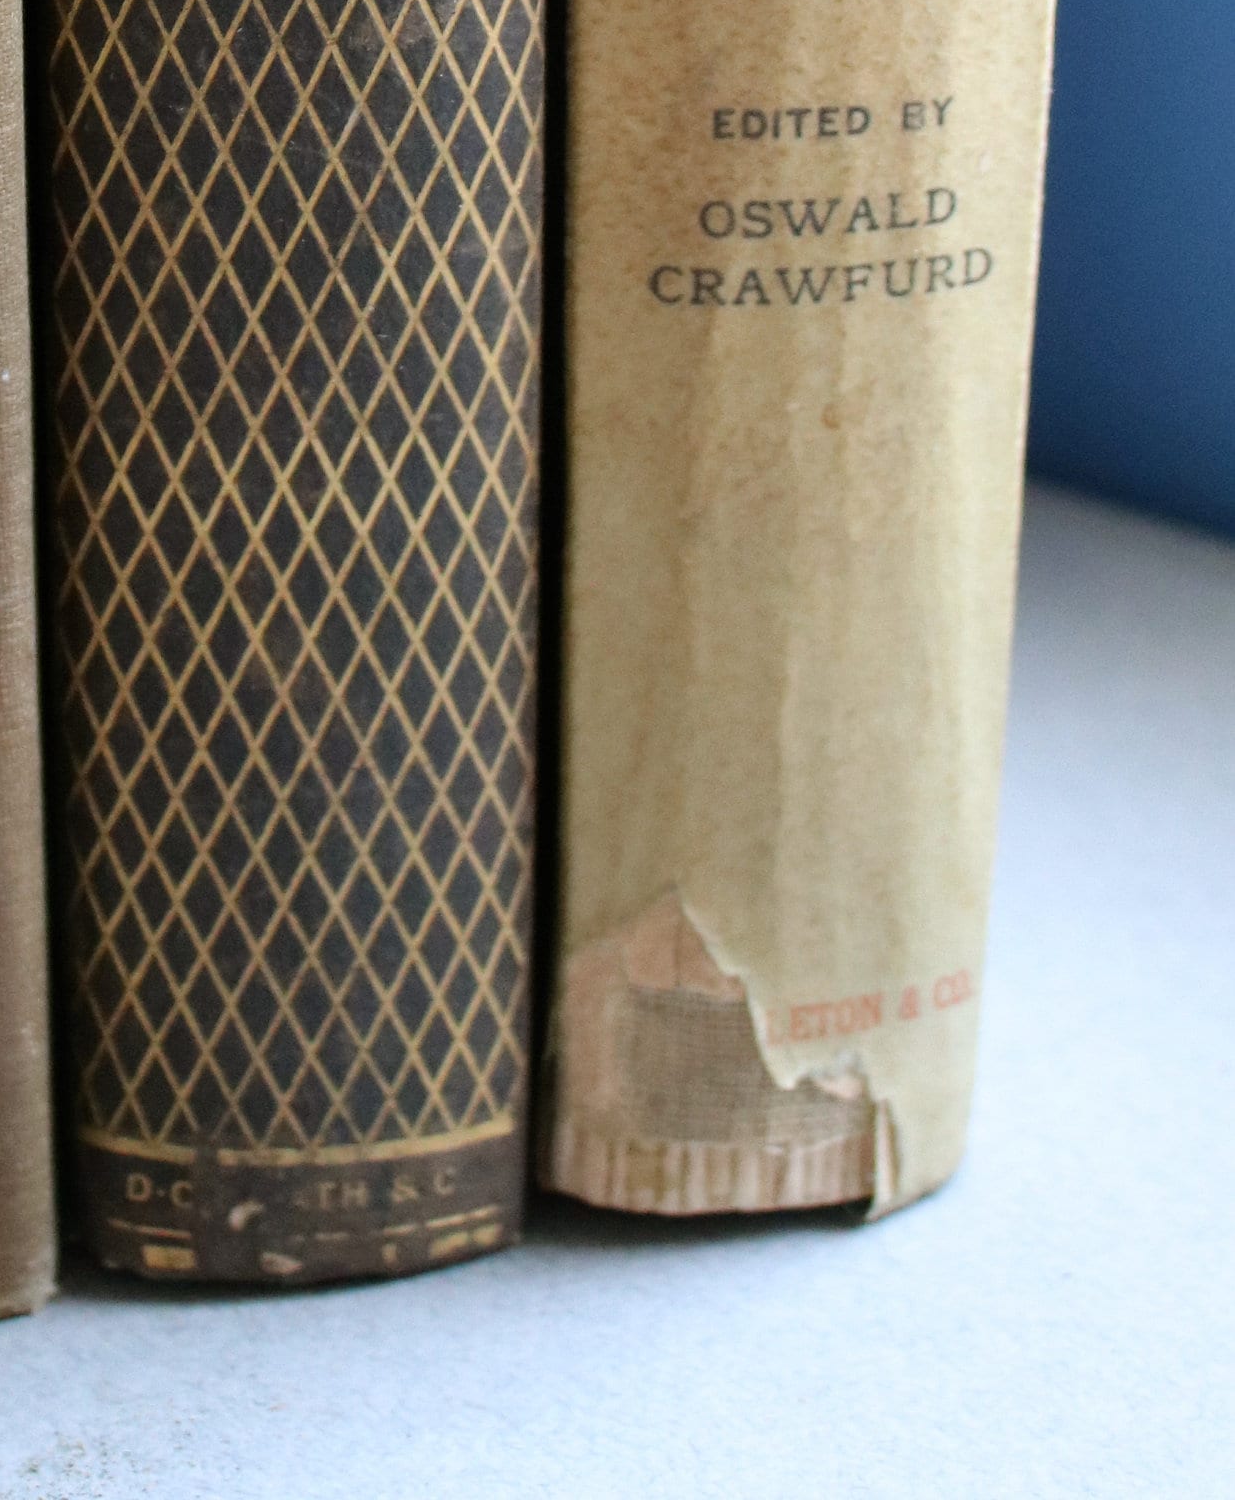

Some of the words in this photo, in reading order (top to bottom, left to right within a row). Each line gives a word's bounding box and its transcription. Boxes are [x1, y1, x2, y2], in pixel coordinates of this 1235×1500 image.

[710, 104, 873, 142] EDITED
[901, 97, 954, 132] BY
[697, 186, 958, 240] OSWALD
[647, 246, 994, 307] CRAWFURD
